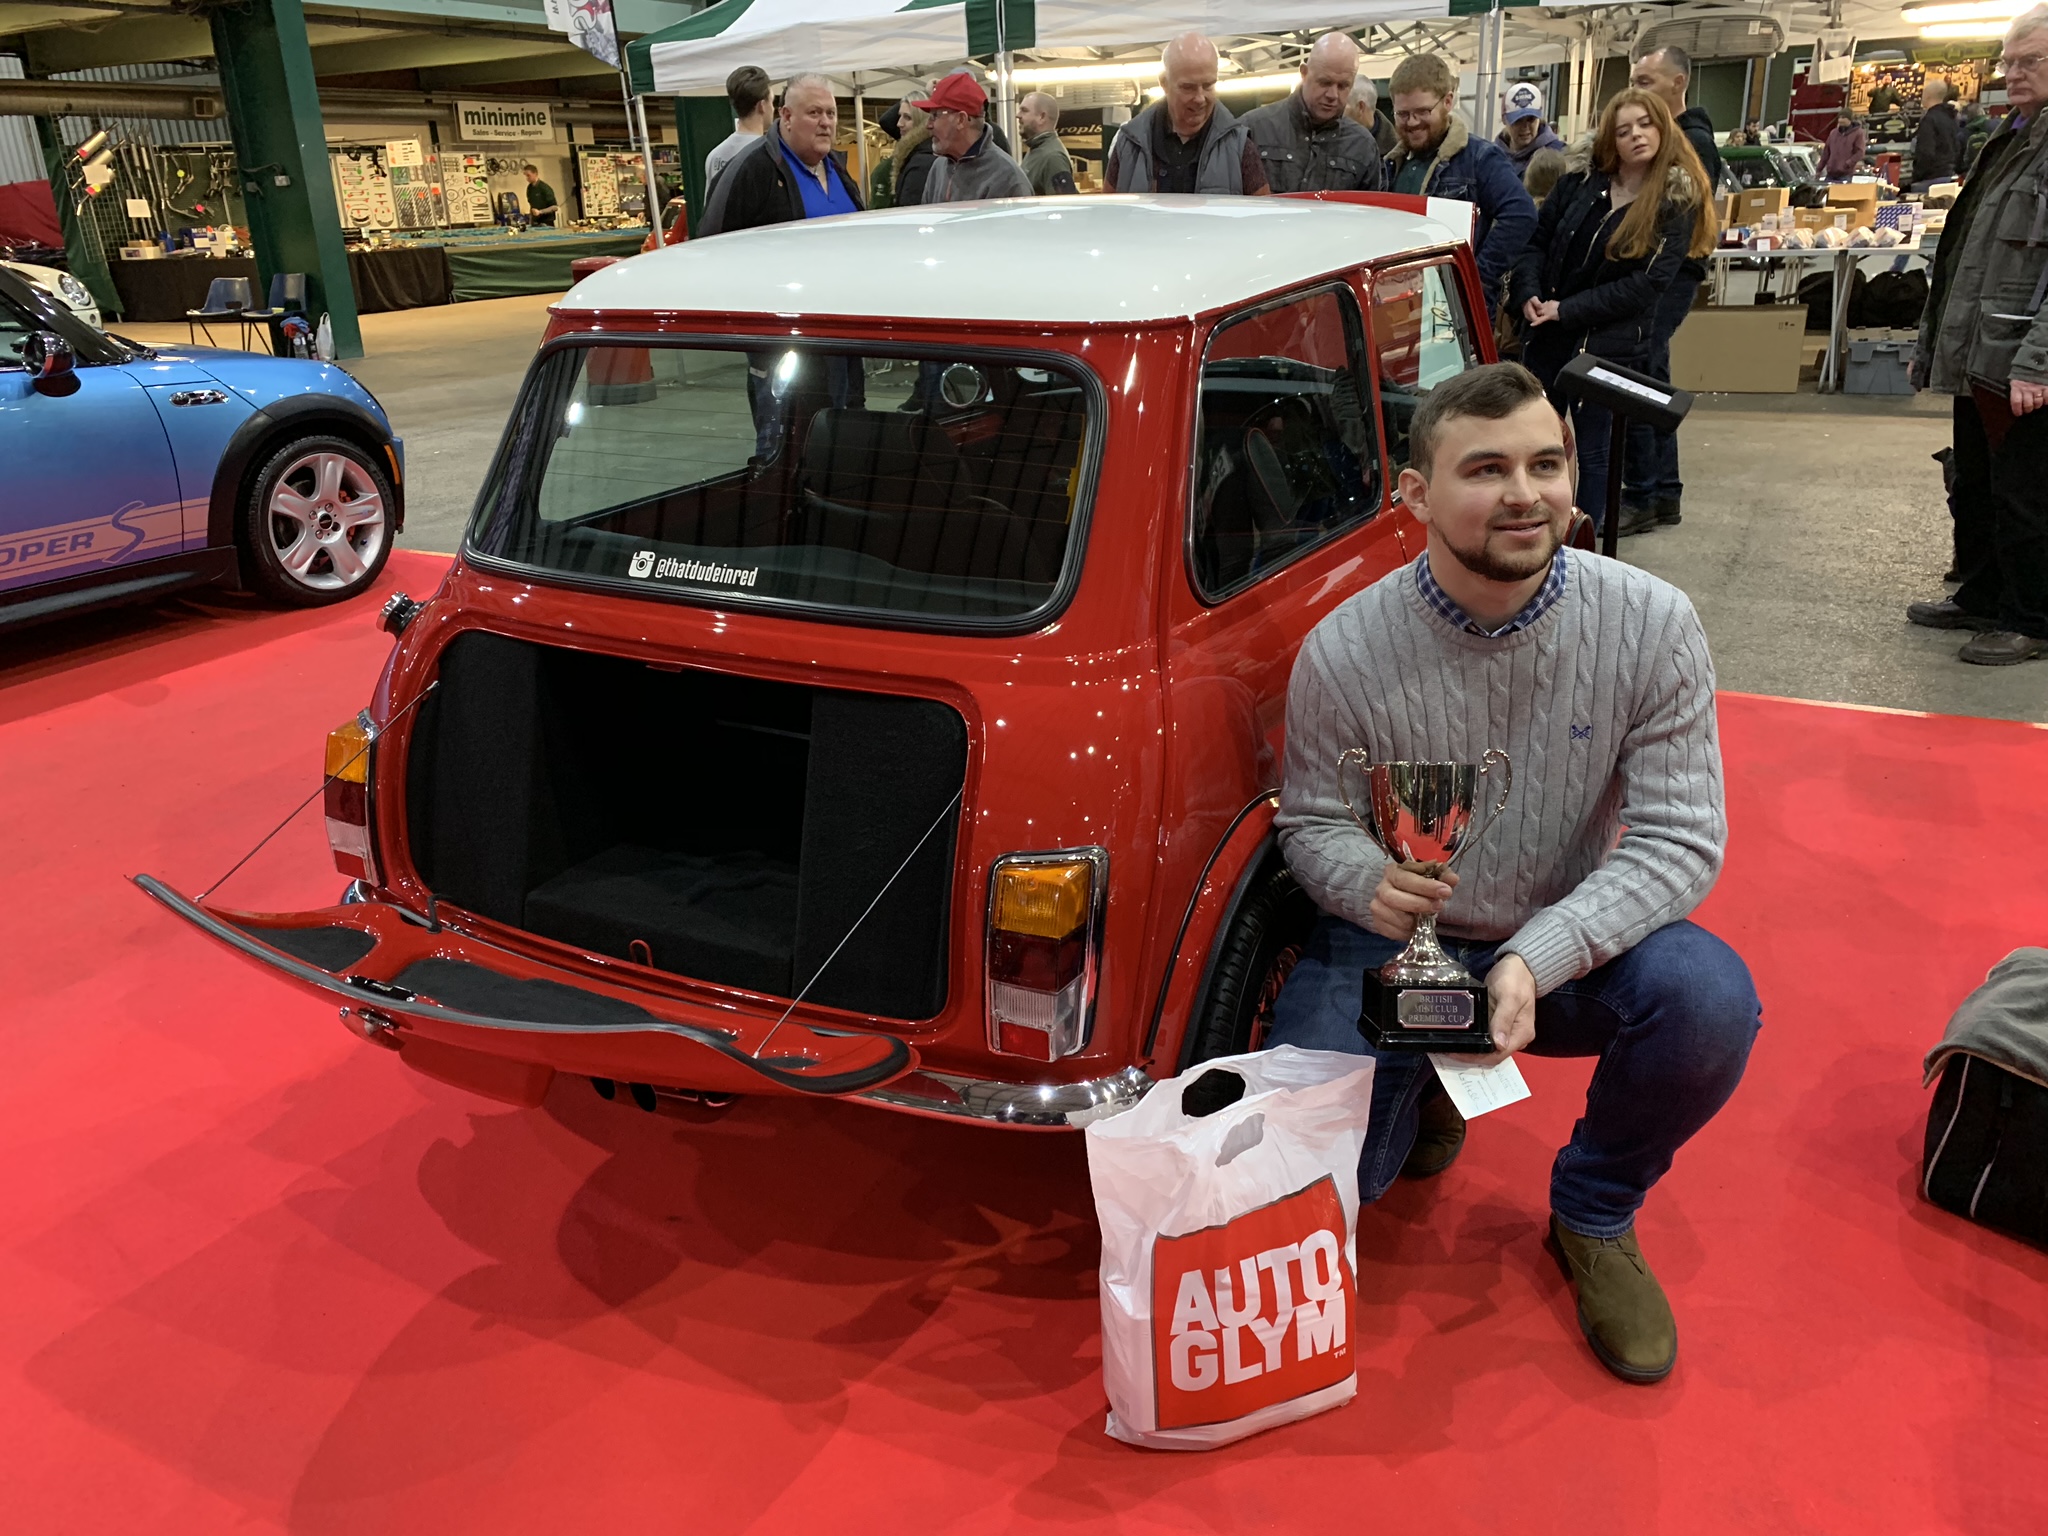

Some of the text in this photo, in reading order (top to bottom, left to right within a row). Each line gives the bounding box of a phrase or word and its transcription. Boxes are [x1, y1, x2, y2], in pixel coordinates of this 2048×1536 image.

[463, 106, 547, 127] minimine
[494, 129, 516, 137] Service
[520, 129, 542, 137] Repairs
[102, 501, 146, 564] S
[655, 558, 758, 587] @thatdudeinred
[1415, 1004, 1458, 1013] MINI CLUB
[1420, 995, 1453, 1003] BRITISH
[1408, 1014, 1465, 1023] PREMIER CUP
[1170, 1229, 1343, 1336] AUTO
[1170, 1288, 1346, 1392] GLYM
